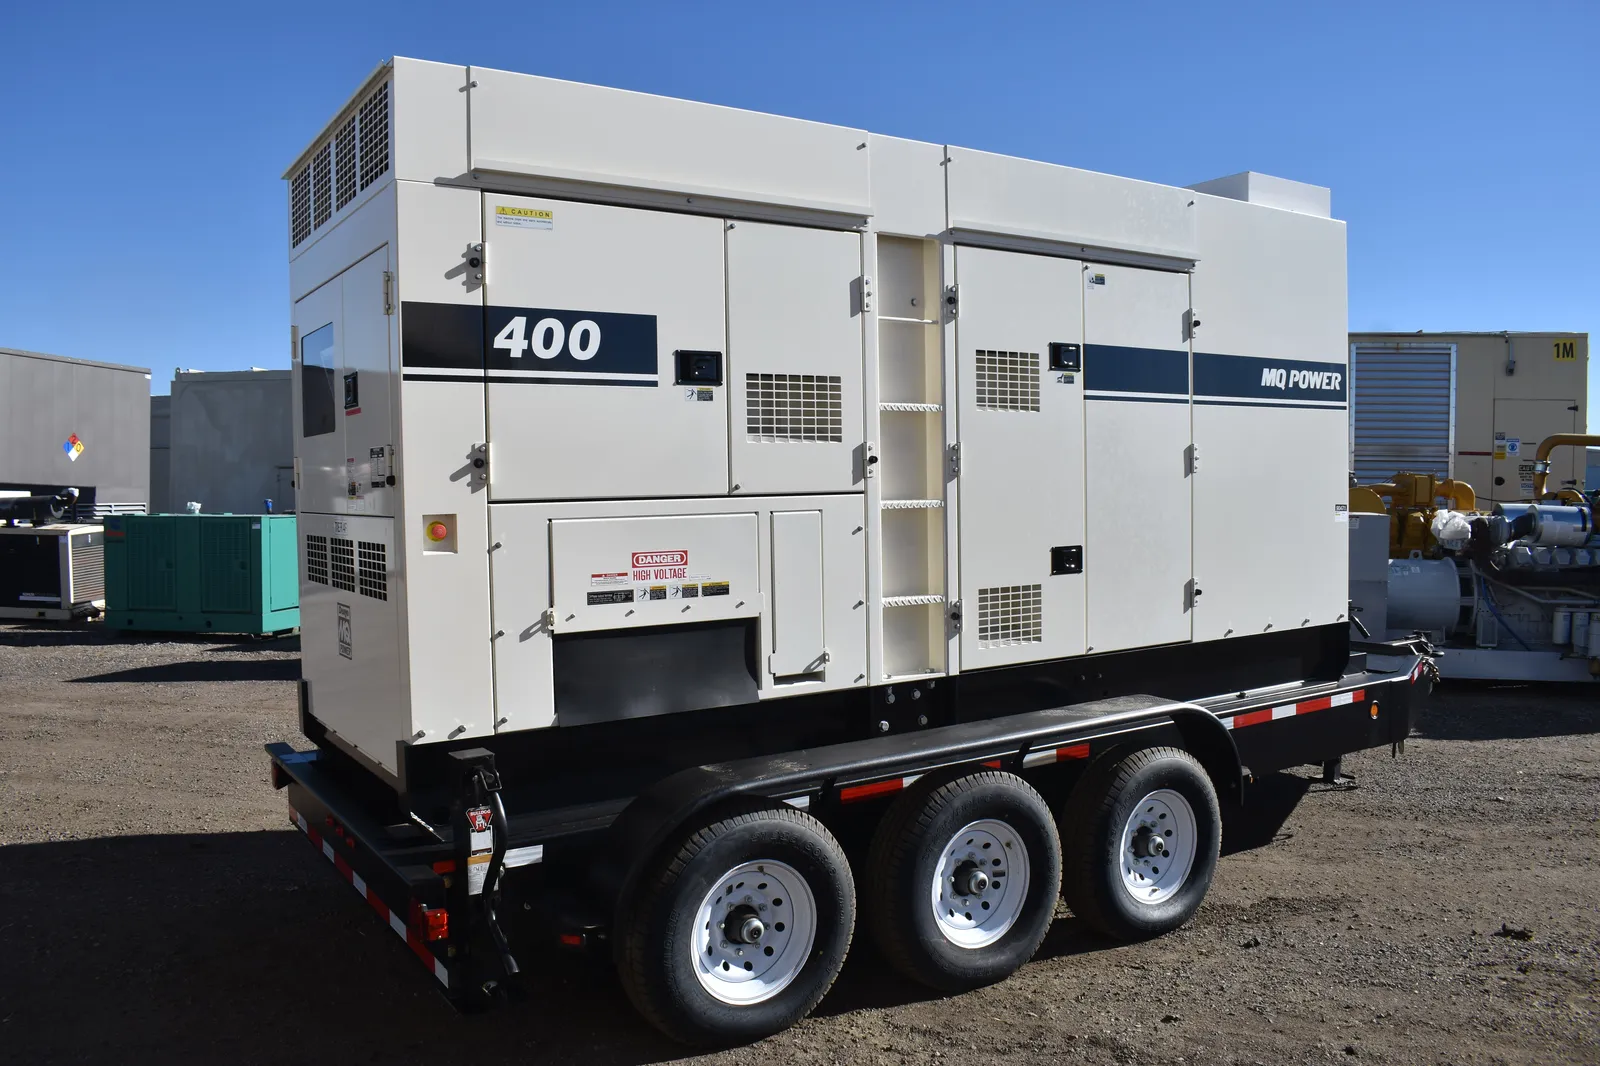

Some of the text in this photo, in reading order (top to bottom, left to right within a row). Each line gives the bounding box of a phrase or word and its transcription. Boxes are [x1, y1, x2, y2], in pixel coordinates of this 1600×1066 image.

[511, 209, 550, 217] CAUTION
[493, 316, 601, 361] 400
[1554, 342, 1574, 359] 1M
[1260, 368, 1342, 390] MQ POWER
[71, 435, 77, 444] 2
[76, 442, 81, 452] 0
[638, 554, 681, 564] DANGER
[633, 569, 651, 581] HIGH
[654, 567, 687, 580] VOLTAGE
